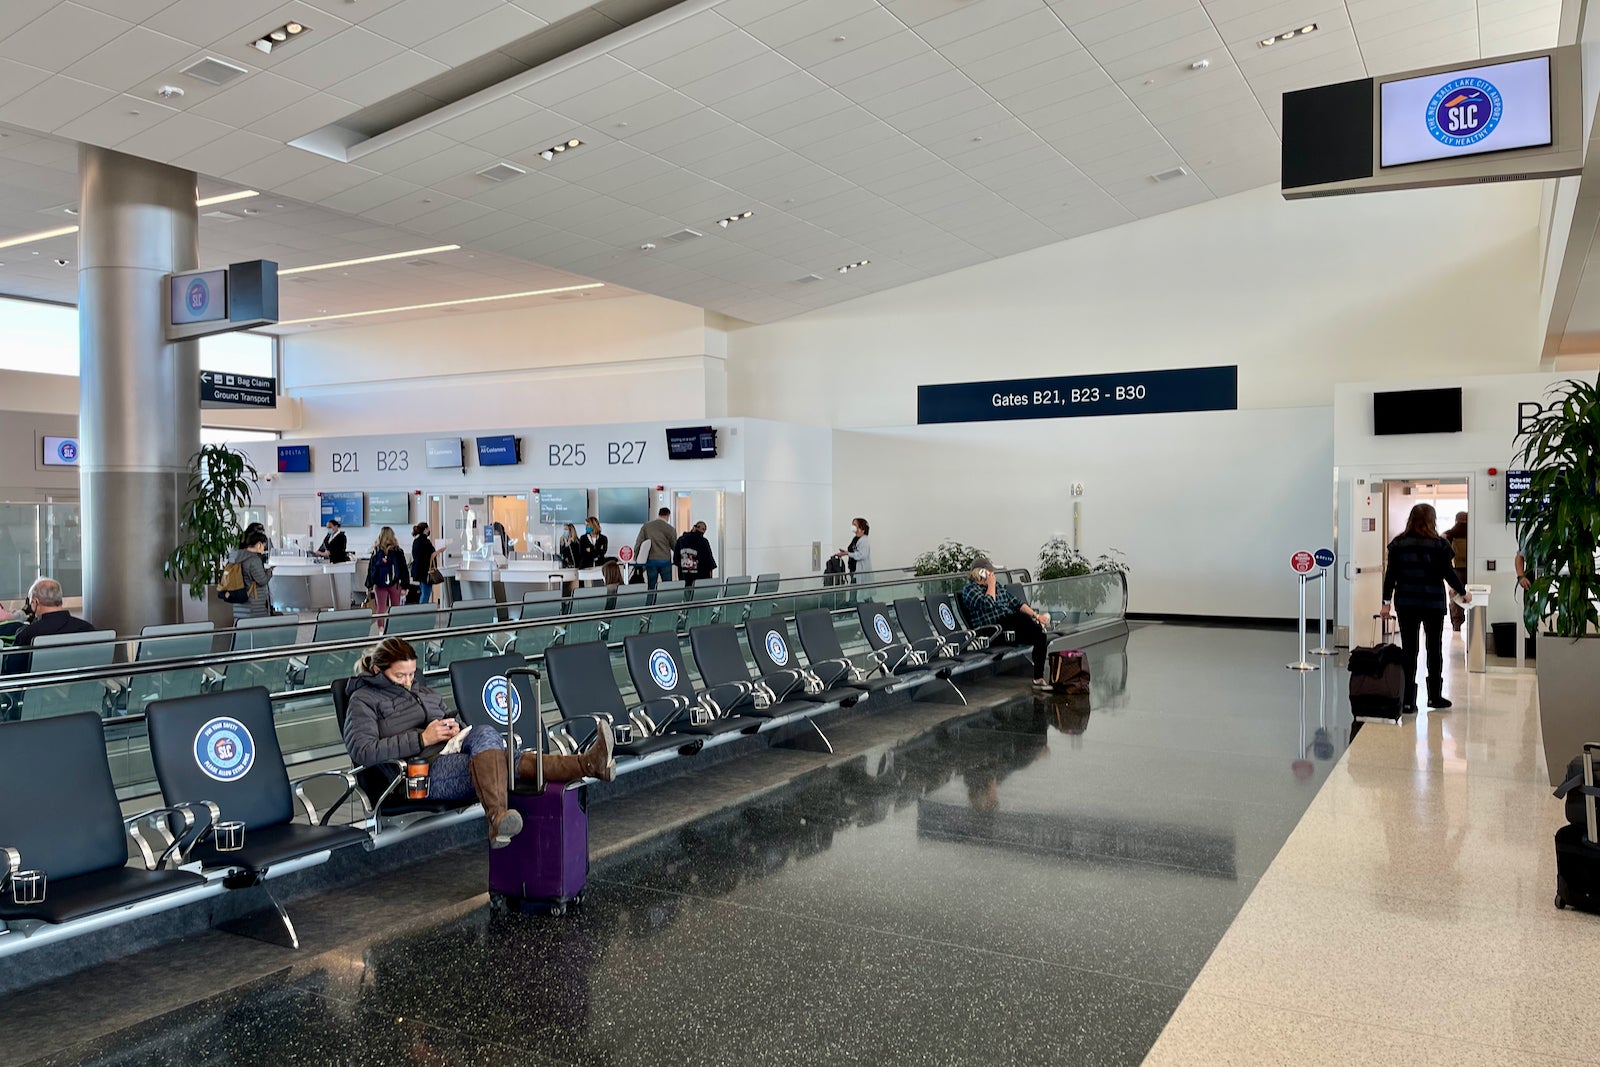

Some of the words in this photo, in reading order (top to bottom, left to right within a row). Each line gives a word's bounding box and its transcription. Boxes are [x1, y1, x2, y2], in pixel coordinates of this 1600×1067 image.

[1455, 79, 1475, 88] LAKE
[1476, 80, 1492, 92] CITY
[1436, 84, 1453, 99] SALT
[1428, 101, 1438, 116] NEW
[1490, 91, 1501, 122] AIRPORT
[1428, 117, 1437, 131] THE
[1448, 104, 1478, 131] SLC
[1440, 134, 1454, 145] FLY
[1456, 129, 1488, 146] HEALTHY
[192, 293, 203, 307] SLC
[237, 377, 251, 387] Bag
[251, 378, 270, 388] Claim
[214, 390, 239, 401] Ground
[240, 393, 270, 404] Transport
[992, 393, 1029, 407] Gates
[1033, 389, 1066, 406] B21,
[1071, 388, 1100, 403] B23
[1115, 385, 1146, 400] B30
[332, 452, 360, 473] B21
[377, 449, 409, 471] B23
[549, 444, 586, 466] B25
[608, 441, 647, 465] B27
[217, 745, 233, 760] SLC
